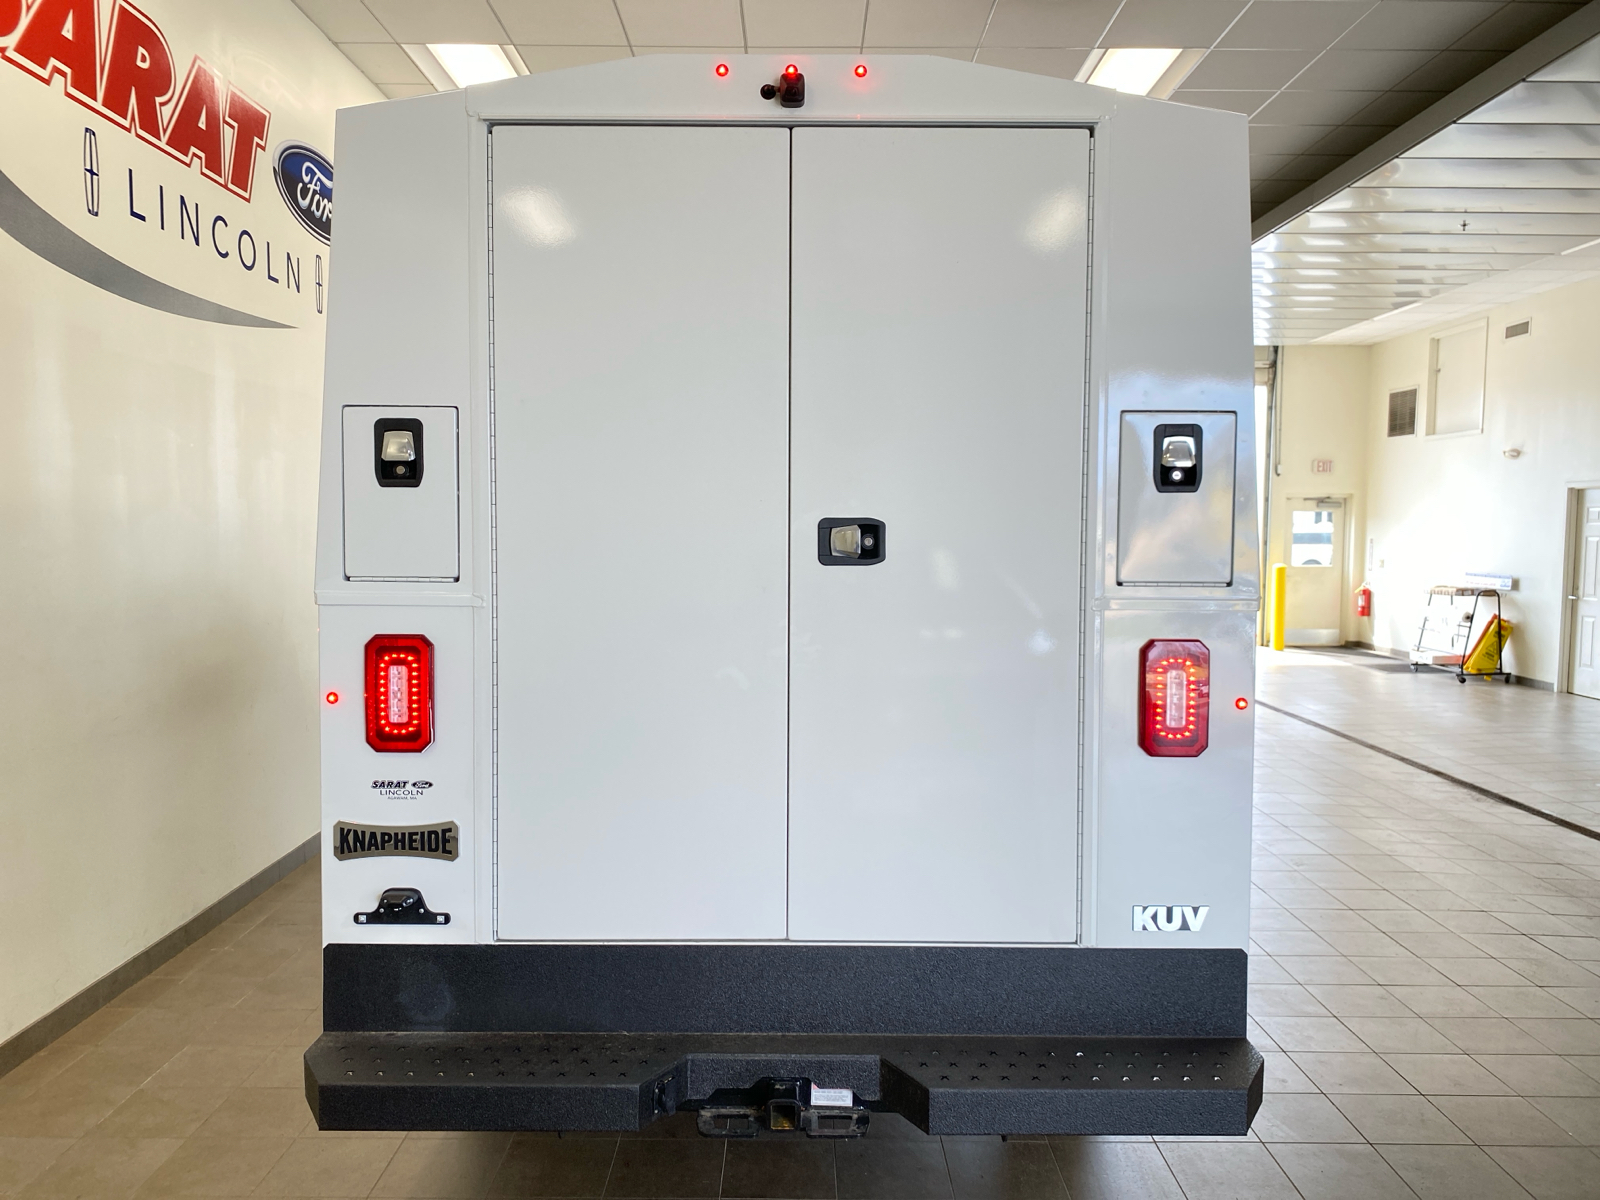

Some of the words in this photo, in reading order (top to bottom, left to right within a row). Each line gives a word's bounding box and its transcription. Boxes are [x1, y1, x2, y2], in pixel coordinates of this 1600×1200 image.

[297, 161, 333, 223] For
[128, 168, 301, 294] LINCOLN
[1316, 459, 1333, 473] EXIT
[371, 780, 409, 789] SARAT
[339, 827, 453, 855] KNAPHEIDE
[1132, 905, 1210, 931] KUV
